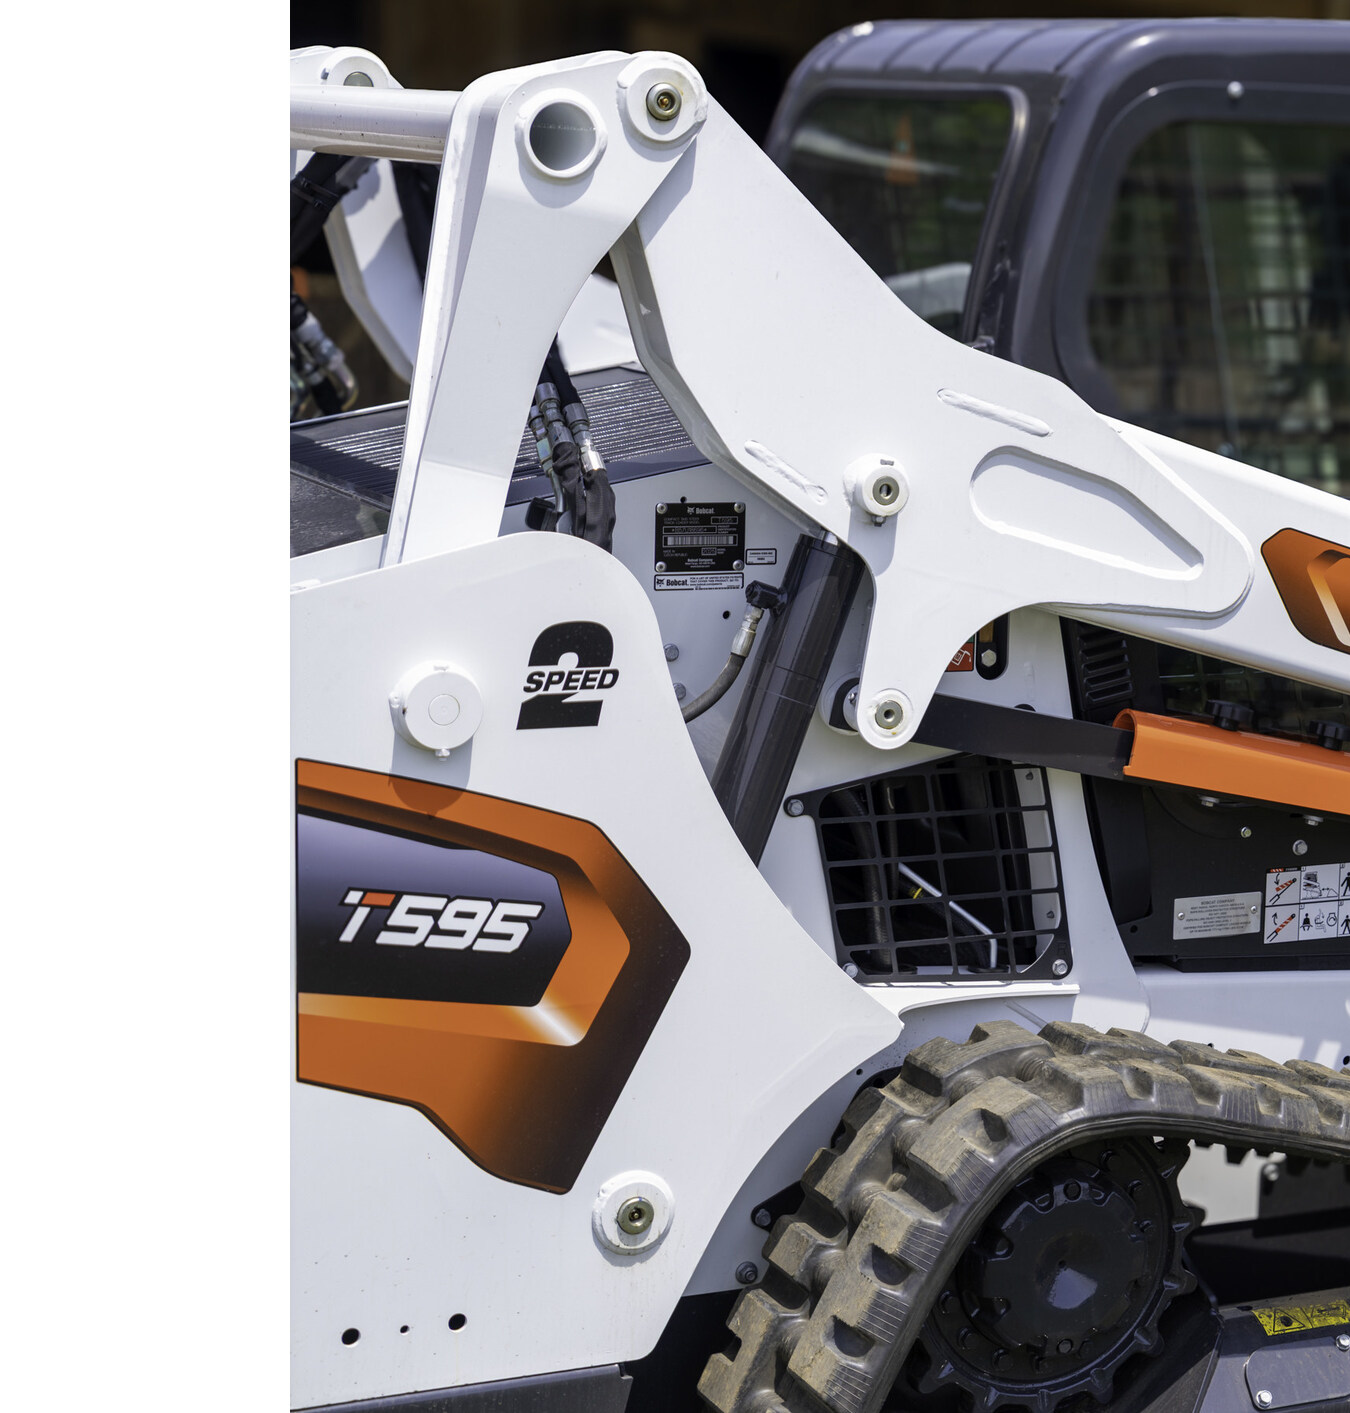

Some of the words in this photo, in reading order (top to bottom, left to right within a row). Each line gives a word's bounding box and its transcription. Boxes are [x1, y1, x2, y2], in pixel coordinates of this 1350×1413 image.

[516, 620, 614, 731] 2
[523, 668, 620, 693] SPEED
[338, 890, 543, 953] T595
